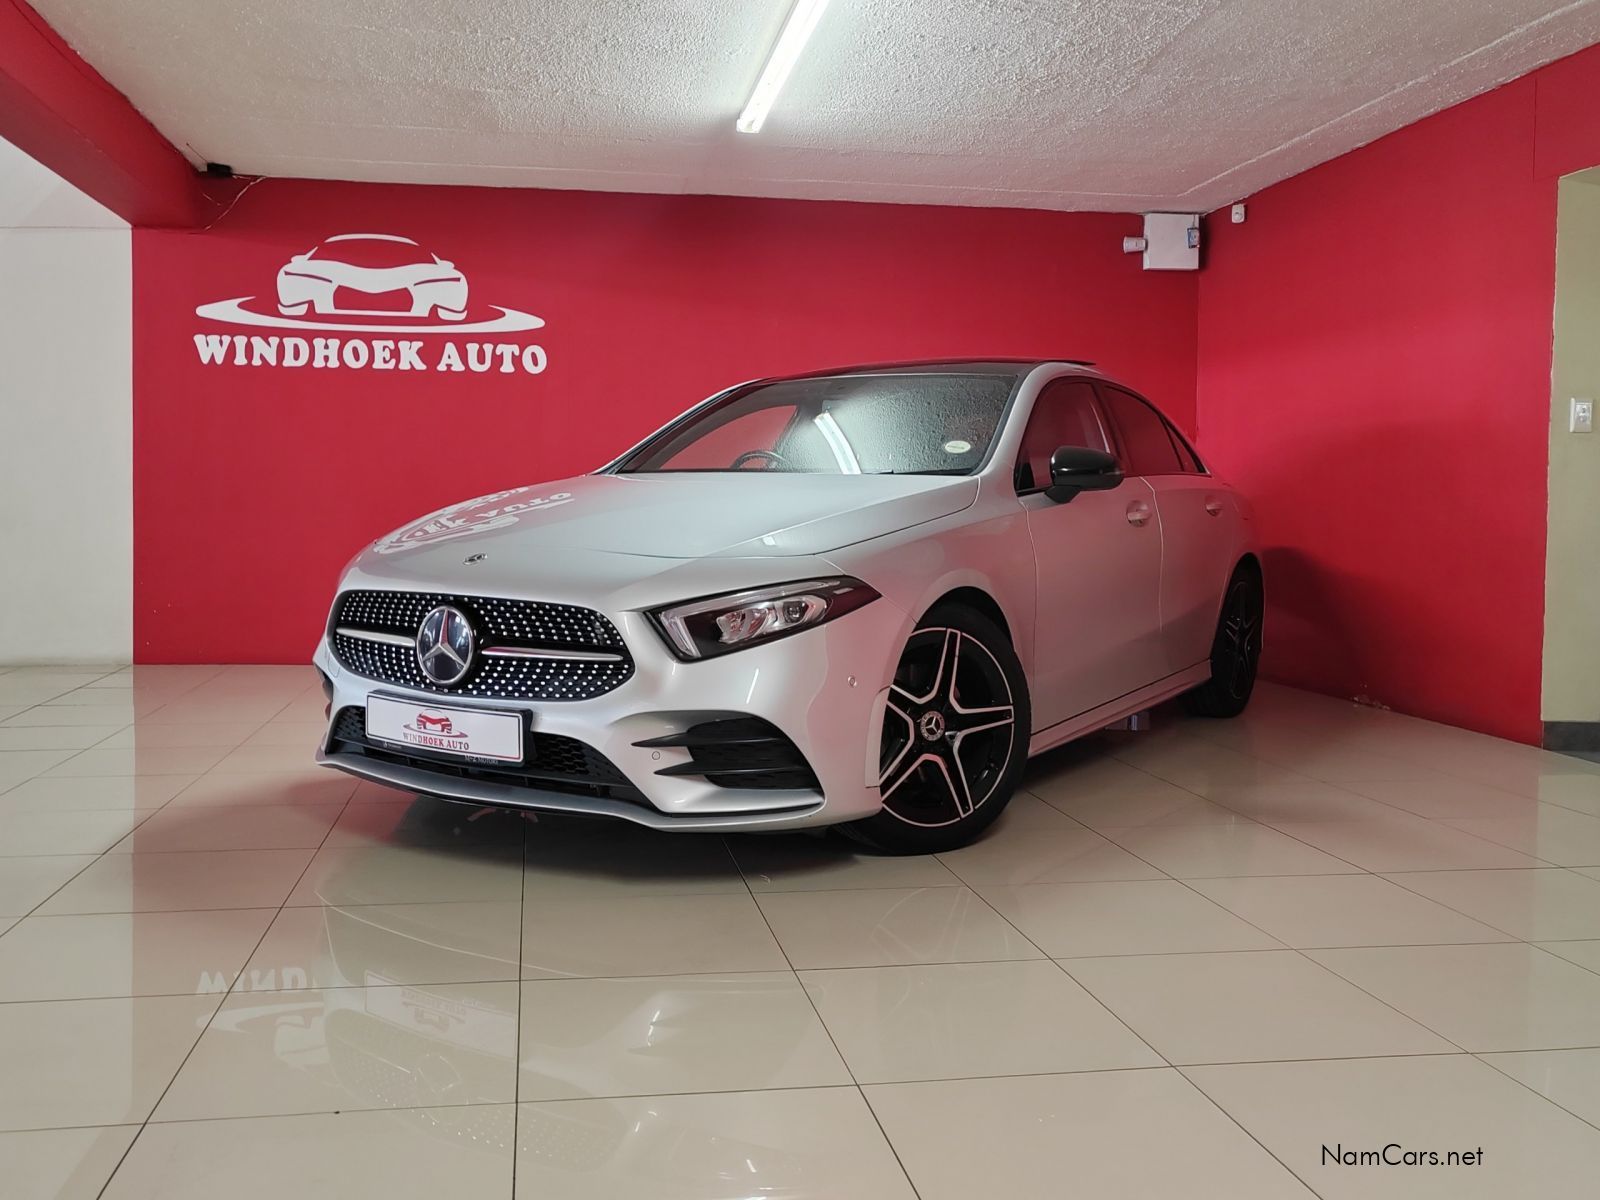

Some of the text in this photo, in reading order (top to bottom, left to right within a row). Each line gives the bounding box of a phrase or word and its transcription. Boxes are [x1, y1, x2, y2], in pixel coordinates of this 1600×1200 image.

[193, 334, 548, 374] WINDHOEK AUTO
[403, 733, 445, 749] WINDHOEK
[446, 740, 470, 751] AUTO
